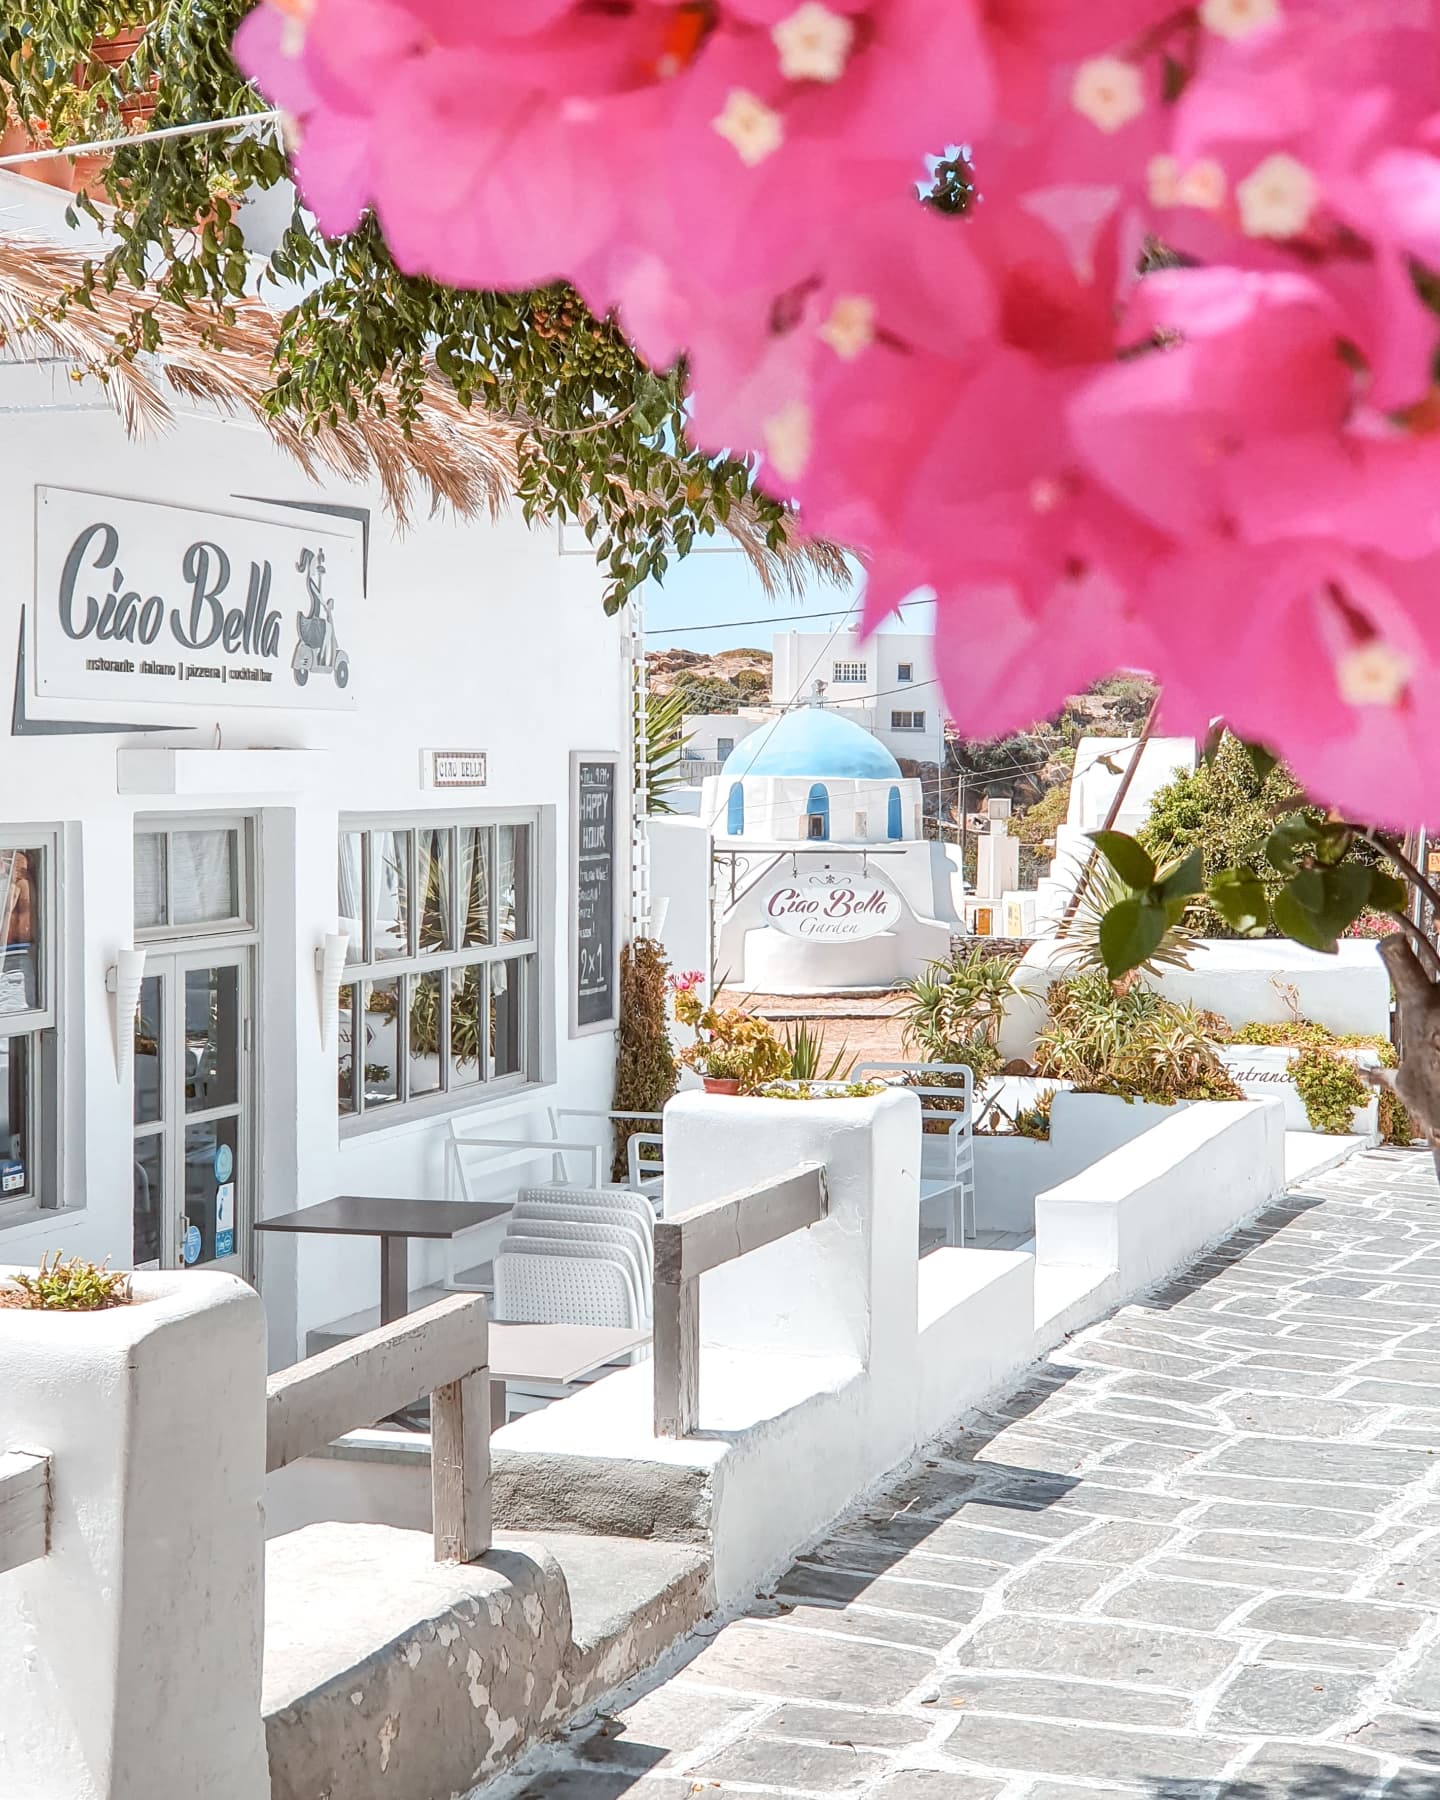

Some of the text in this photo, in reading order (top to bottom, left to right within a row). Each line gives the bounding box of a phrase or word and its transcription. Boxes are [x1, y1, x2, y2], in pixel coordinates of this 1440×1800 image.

[59, 522, 282, 658] Ciao Bella
[86, 657, 135, 673] ristorante
[139, 660, 176, 676] italiano
[185, 664, 220, 680] pizzeria
[260, 669, 273, 682] bar
[580, 792, 608, 820] HAPPY
[583, 825, 606, 849] HOUR
[768, 888, 888, 918] Ciao Bella
[799, 917, 859, 935] Garden
